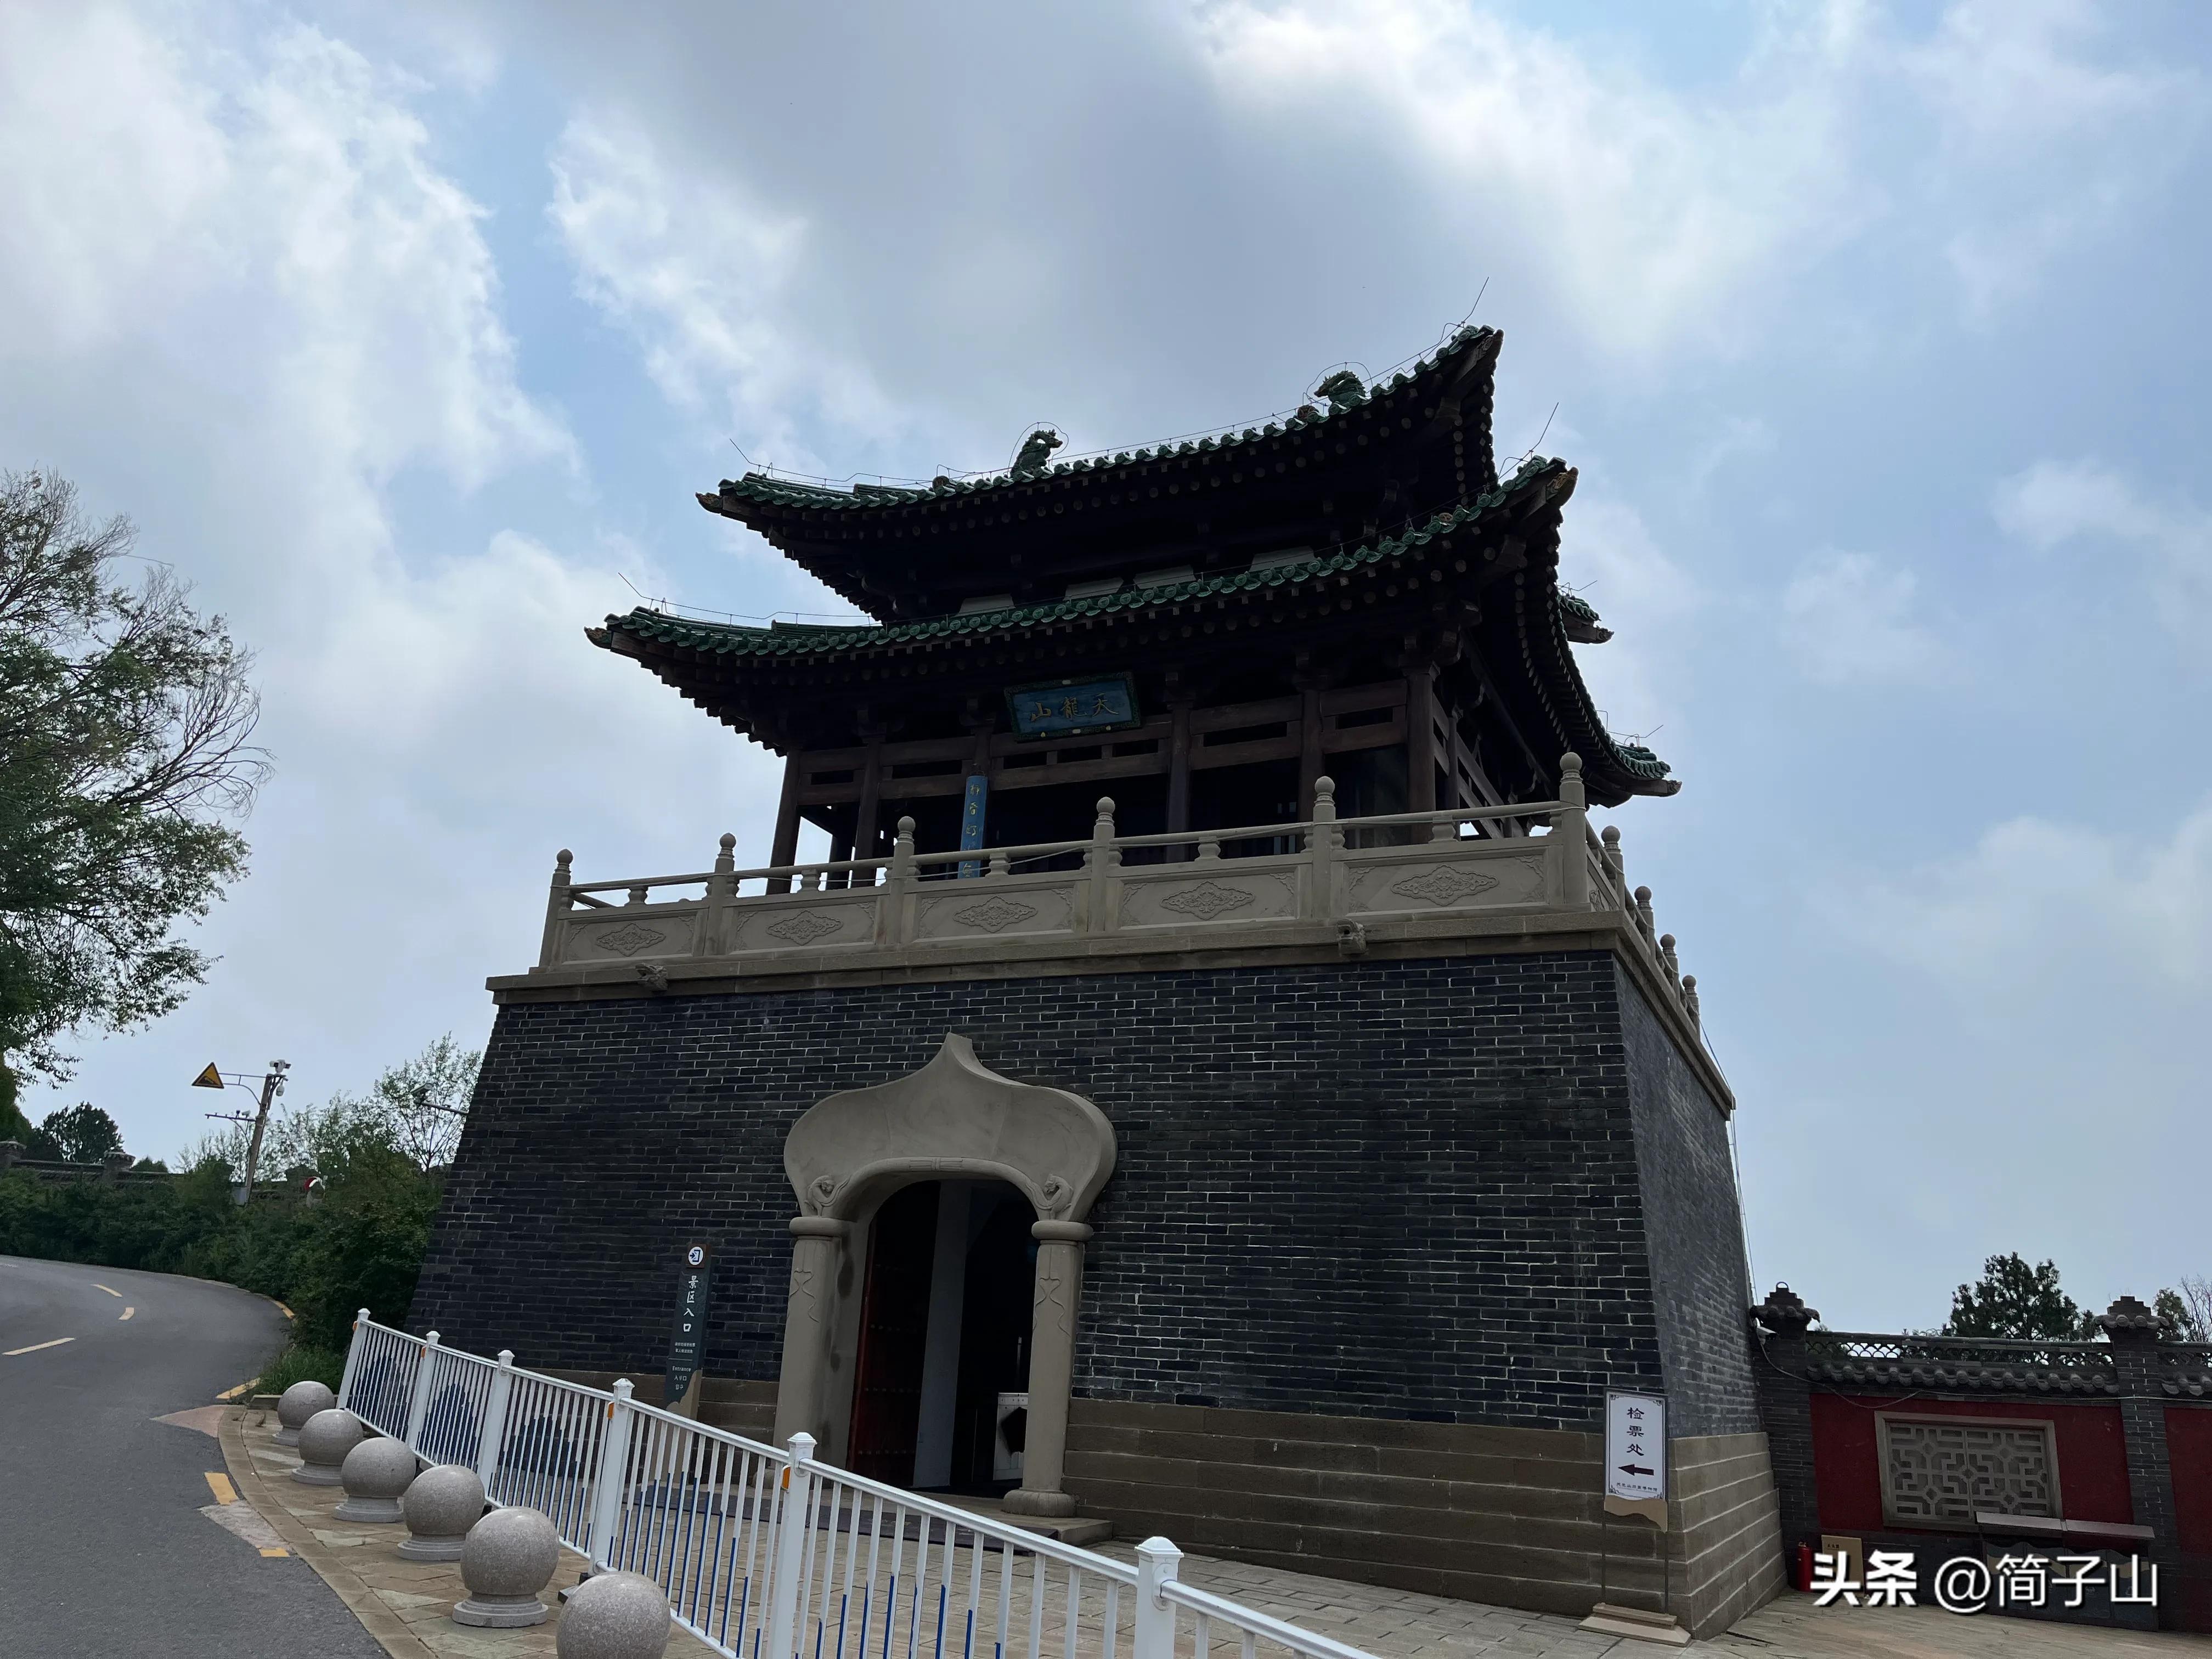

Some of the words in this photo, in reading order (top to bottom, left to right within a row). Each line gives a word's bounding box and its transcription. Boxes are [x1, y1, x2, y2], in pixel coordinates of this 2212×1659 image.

[1030, 693, 1120, 722] 天龍山
[683, 1275, 698, 1333] 景区入口
[1627, 1407, 1644, 1457] 检票处
